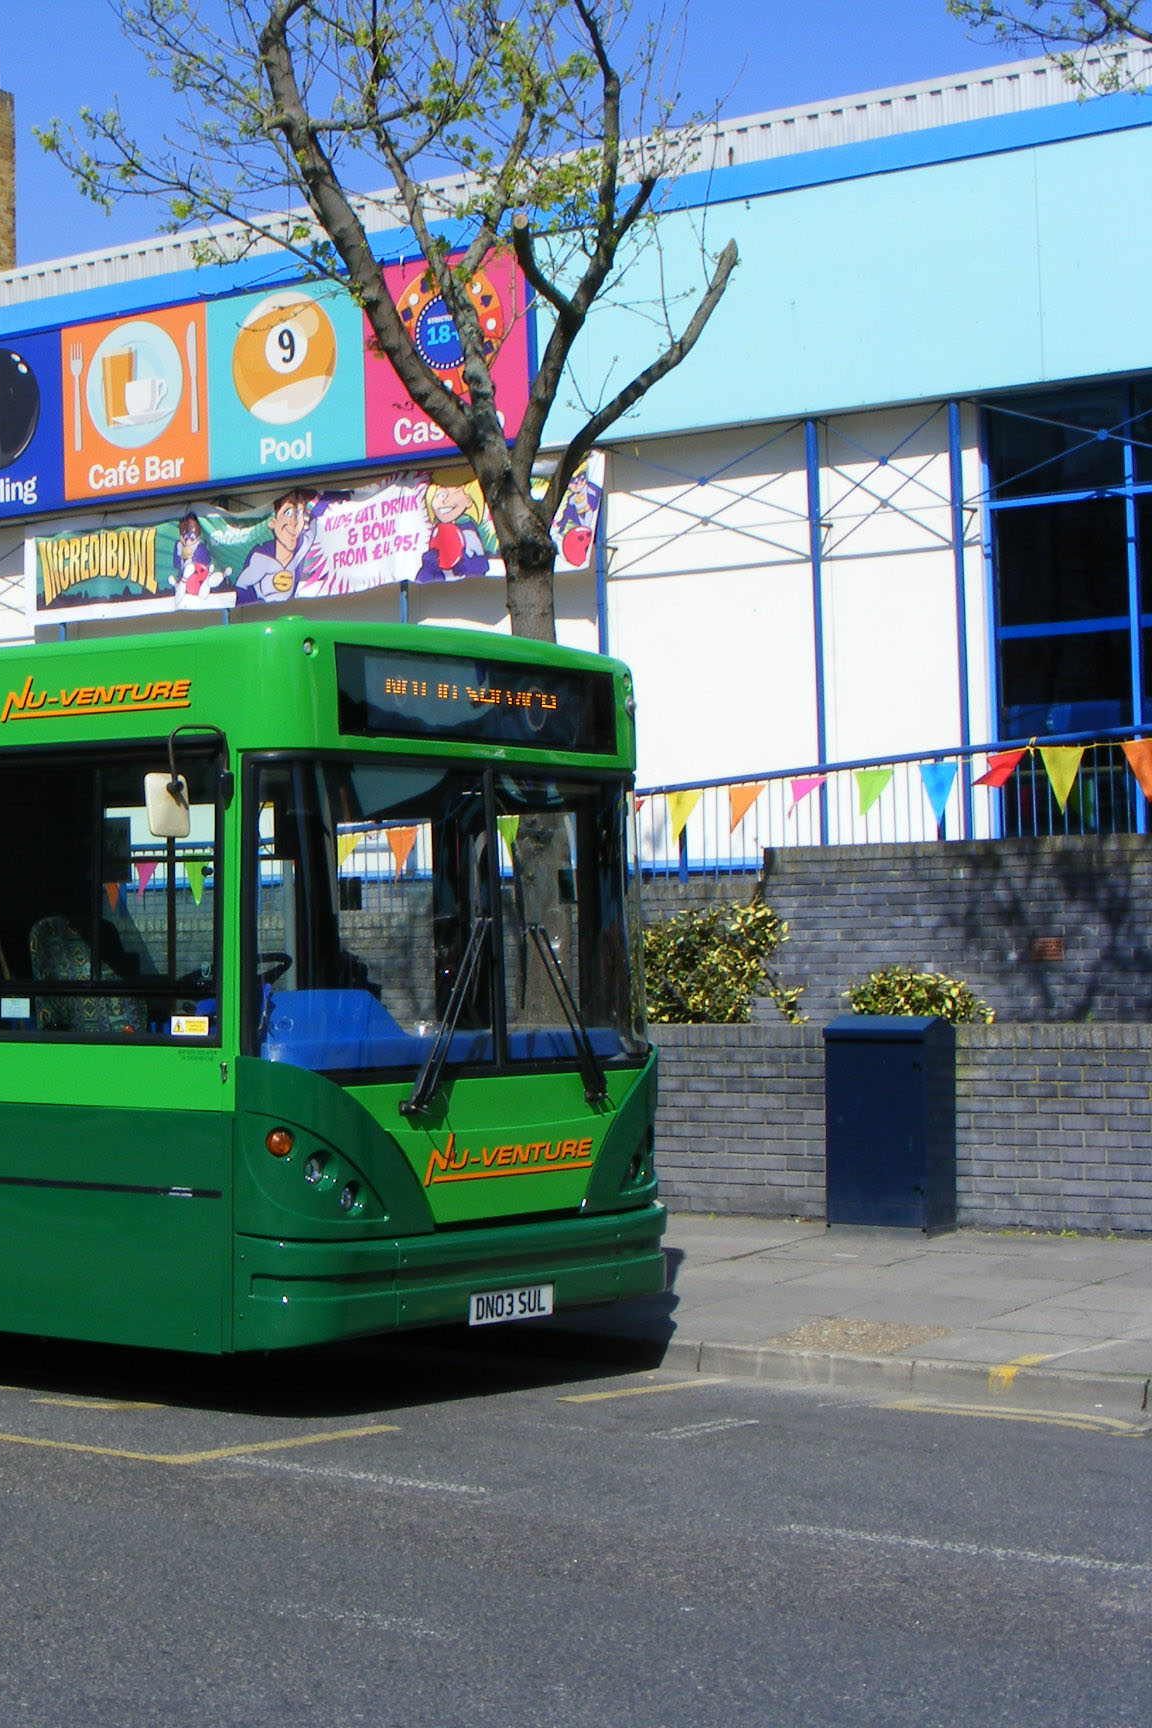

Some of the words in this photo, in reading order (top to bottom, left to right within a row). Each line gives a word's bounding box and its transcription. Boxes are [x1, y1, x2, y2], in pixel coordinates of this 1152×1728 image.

[278, 328, 295, 364] 9
[260, 431, 313, 465] Pool
[88, 457, 139, 490] Café
[145, 456, 185, 482] Bar
[325, 512, 353, 532] KIDS
[381, 495, 418, 518] DRINK
[348, 528, 359, 546] &
[362, 519, 396, 543] BOWL
[39, 527, 158, 606] INCREDIBOWL
[333, 545, 368, 570] FROM
[372, 532, 419, 561] £4.95!
[476, 1293, 514, 1321] DN03
[518, 1289, 546, 1314] SUL
